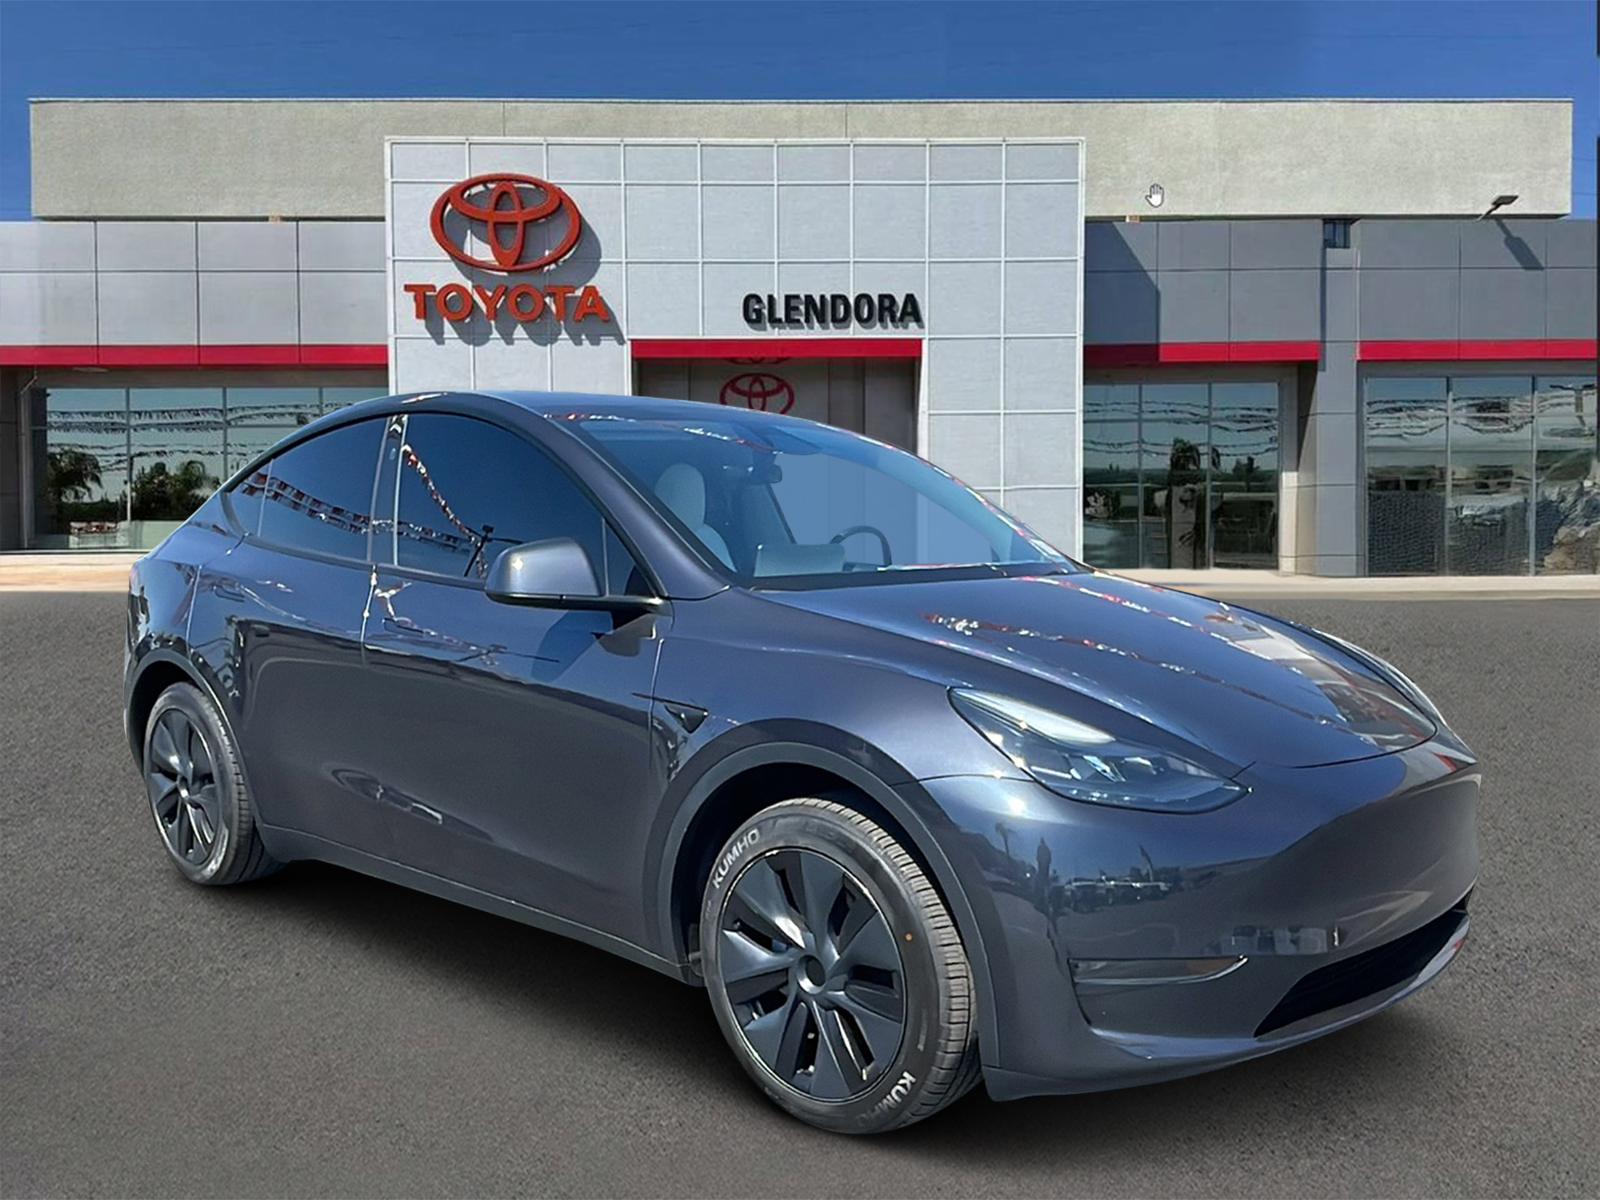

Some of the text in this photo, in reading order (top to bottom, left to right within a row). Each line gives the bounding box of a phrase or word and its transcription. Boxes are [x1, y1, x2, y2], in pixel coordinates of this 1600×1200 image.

[404, 283, 610, 322] TOYOTA
[743, 293, 922, 325] GLENDORA
[712, 828, 761, 889] KUMHO
[863, 1071, 916, 1117] KUM
